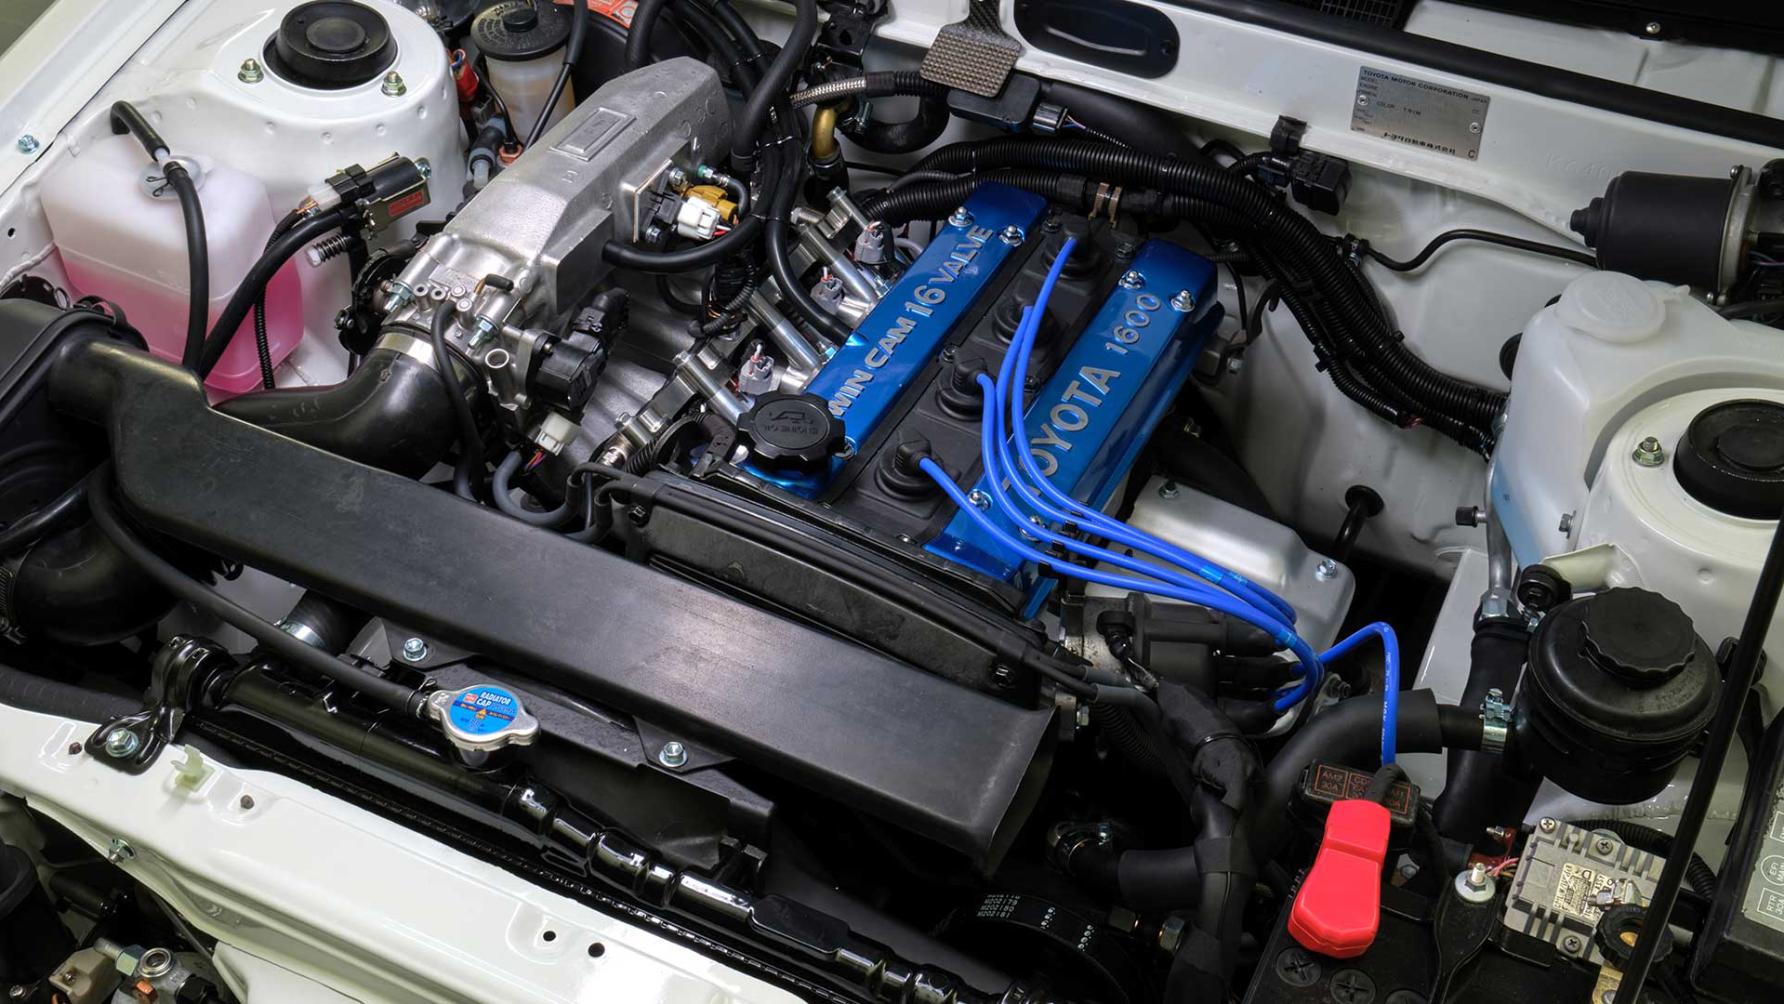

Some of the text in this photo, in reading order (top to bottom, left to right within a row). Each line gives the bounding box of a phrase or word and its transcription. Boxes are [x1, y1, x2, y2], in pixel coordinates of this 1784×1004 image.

[1363, 69, 1389, 81] TOYOTA
[1391, 76, 1417, 88] MOTOR
[1418, 82, 1469, 100] CORPORATION
[828, 224, 993, 417] WIN CAM 16 VALVE
[1105, 293, 1161, 355] 1600
[476, 698, 492, 707] CAP
[480, 691, 511, 706] RADIATOR
[1766, 894, 1777, 911] RTR
